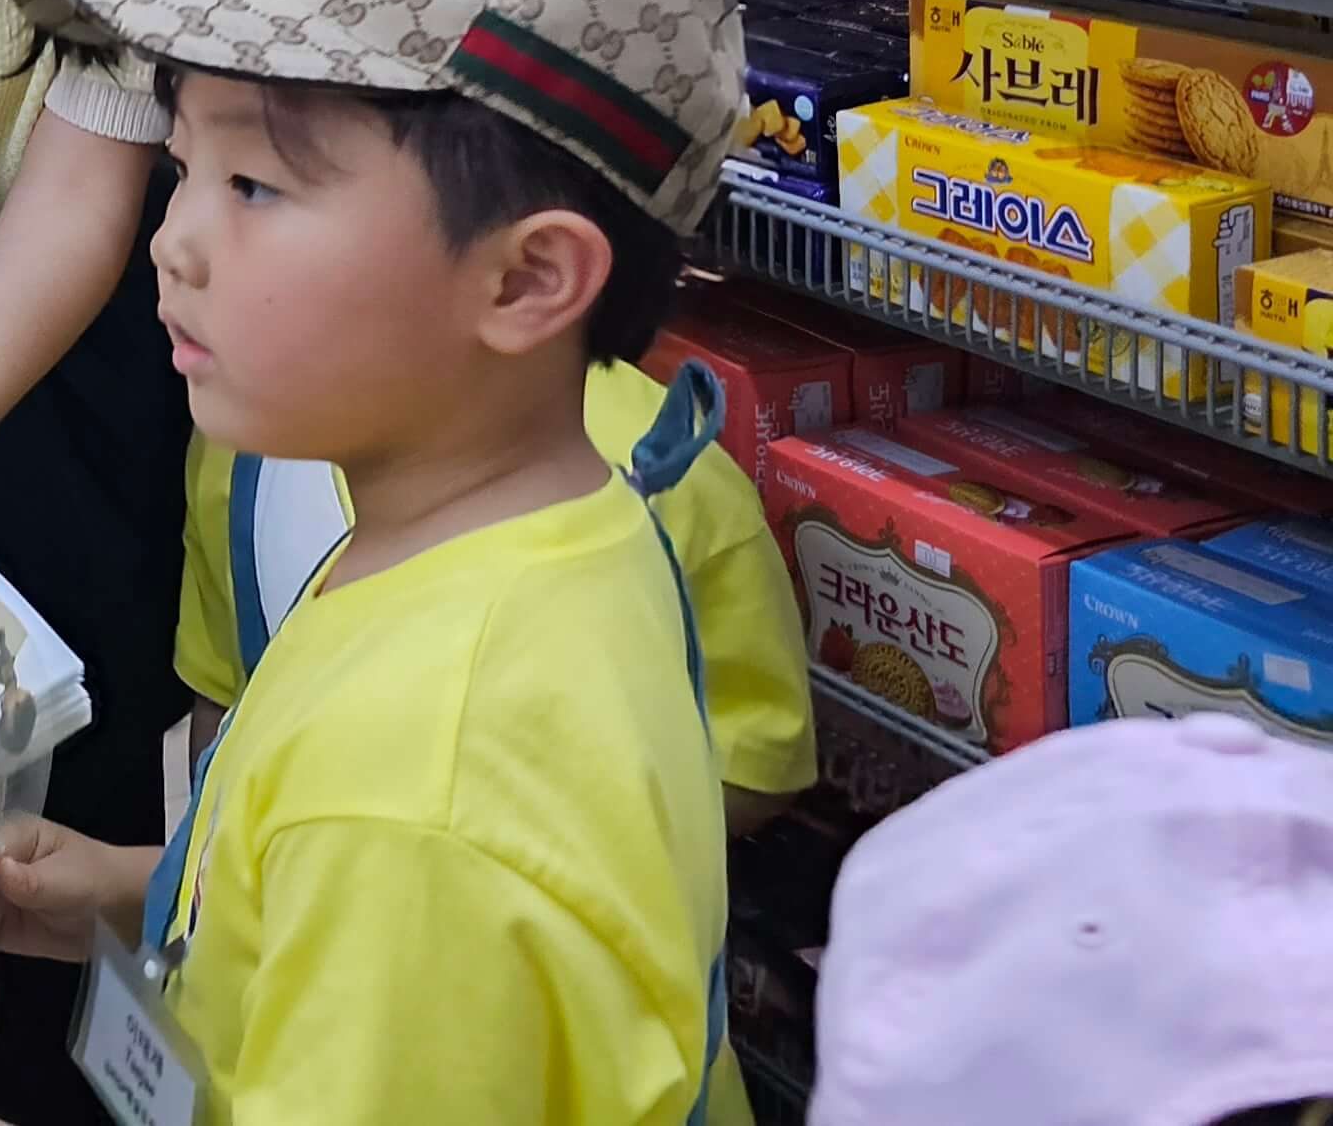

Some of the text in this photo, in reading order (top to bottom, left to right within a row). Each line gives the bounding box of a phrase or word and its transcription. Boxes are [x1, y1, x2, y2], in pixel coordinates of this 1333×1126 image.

[949, 45, 1100, 126] 사브레
[904, 136, 942, 155] CROWN
[910, 166, 1095, 263] 그레이스
[776, 470, 817, 501] CROWN
[817, 562, 971, 670] 크라운산도
[1083, 593, 1140, 631] CROWN
